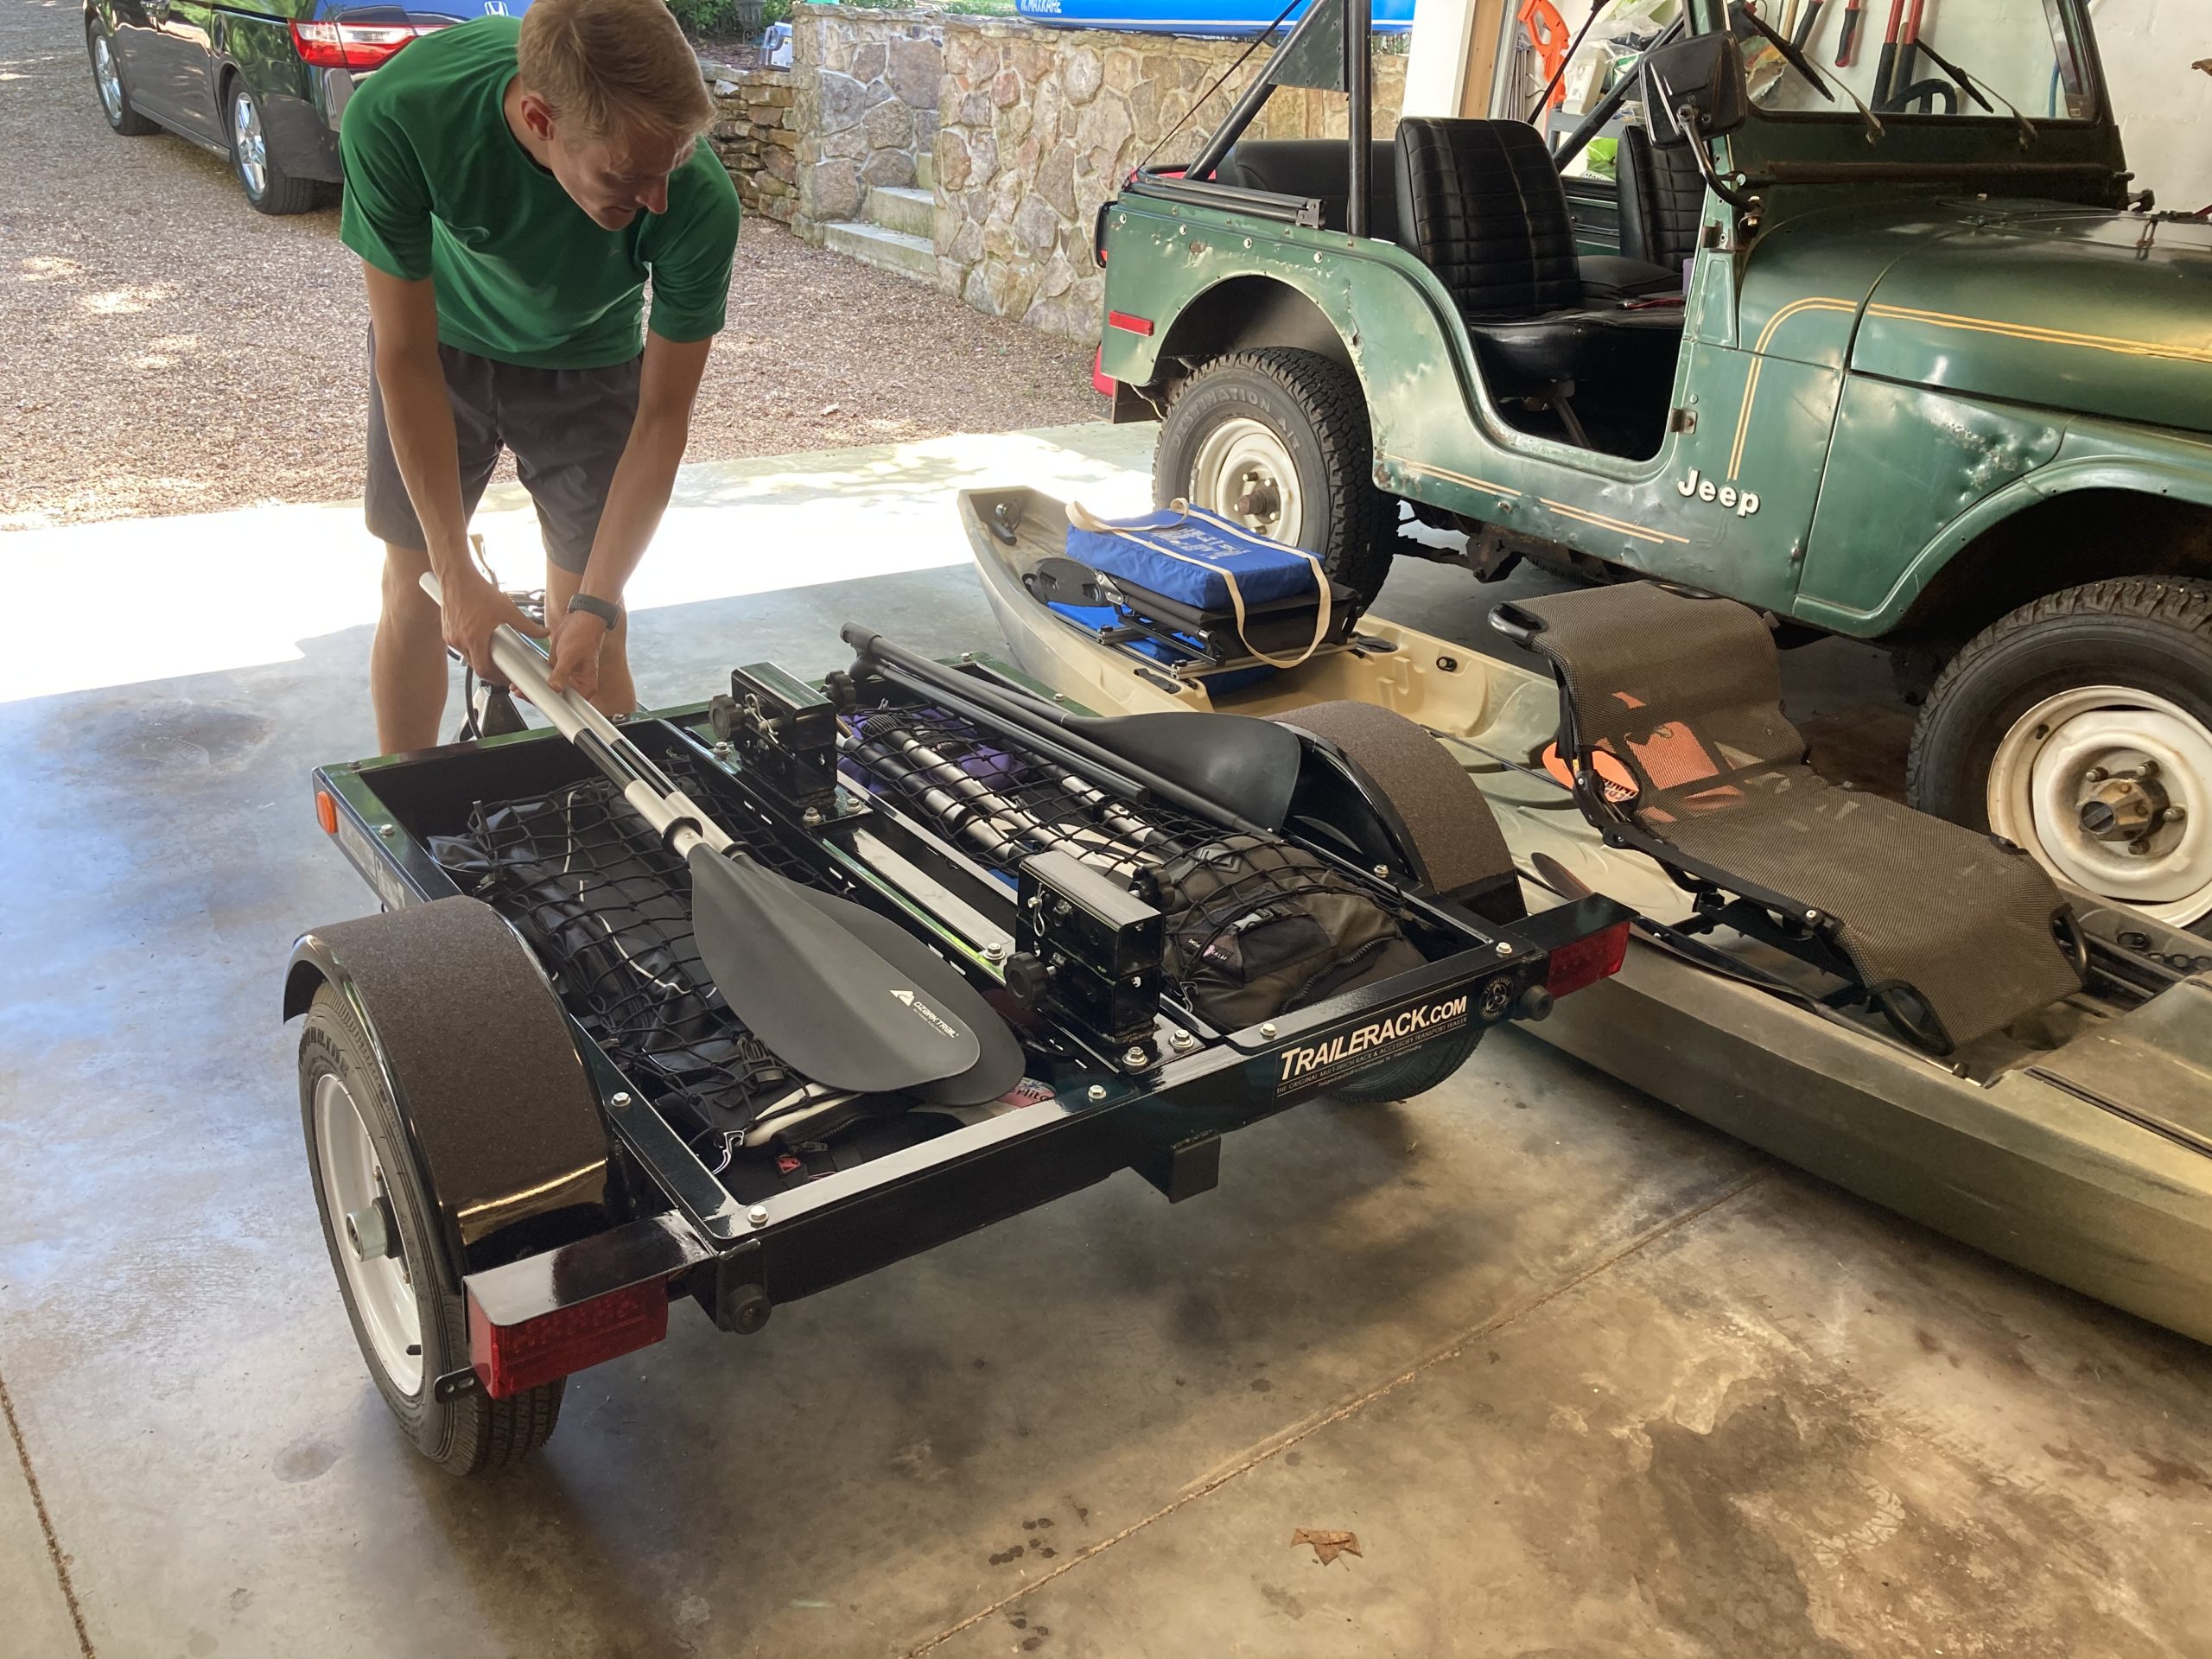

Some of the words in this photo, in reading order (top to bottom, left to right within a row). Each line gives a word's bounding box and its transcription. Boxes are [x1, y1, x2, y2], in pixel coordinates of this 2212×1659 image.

[1175, 387, 1272, 448] DESTINATION
[1676, 467, 1761, 518] Jeep
[1281, 995, 1468, 1081] TRAILERACK.COM
